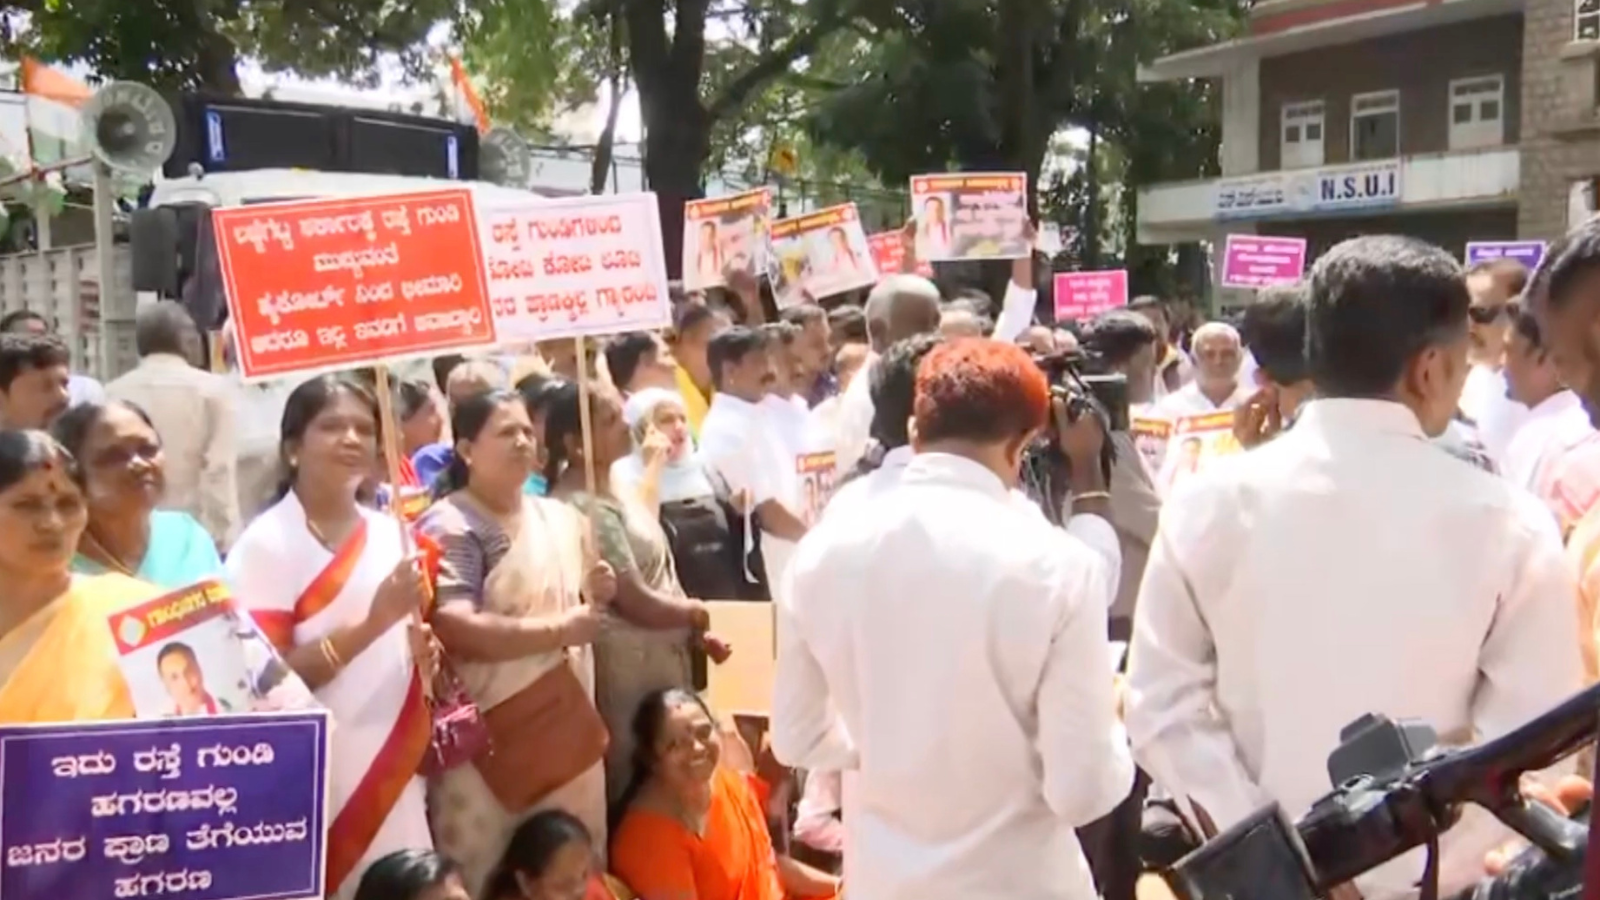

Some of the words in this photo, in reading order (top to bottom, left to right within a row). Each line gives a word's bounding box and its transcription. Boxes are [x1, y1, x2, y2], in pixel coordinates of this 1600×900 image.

[1321, 172, 1395, 201] N.S.U.I
[381, 204, 411, 235] ರಸ್ತೆ
[416, 203, 459, 226] ಗುಂಡಿ
[51, 749, 117, 778] ಇದು
[133, 742, 182, 780] ರಸ್ತೆ
[197, 740, 275, 768] ಗುಂಡಿ
[91, 783, 238, 817] ಹಗರಣವಲ್ಲ
[7, 836, 87, 867] ಜನರ
[104, 831, 170, 865] ಪ್ರಾಣ
[186, 816, 307, 851] ತೆಗೆಯುವ
[114, 867, 213, 898] ಹಗರಣ
